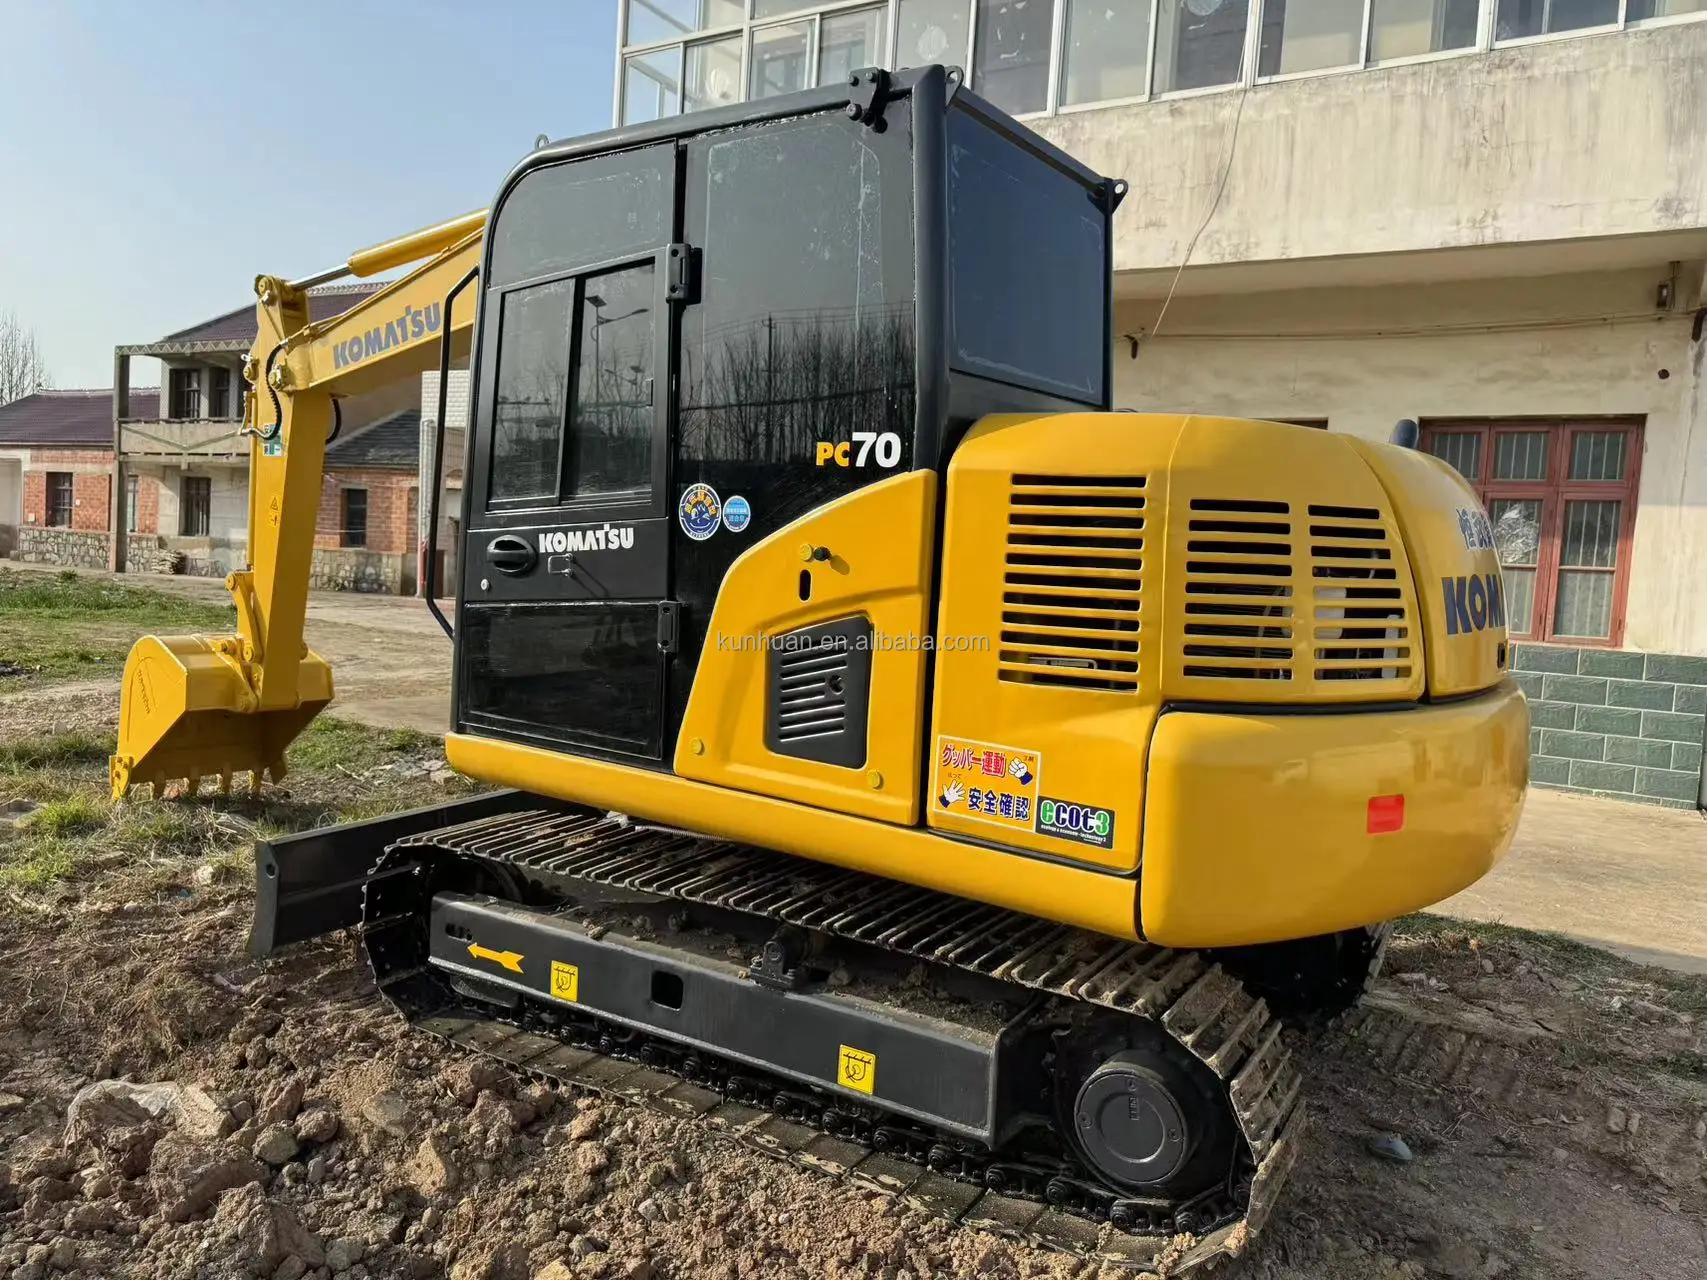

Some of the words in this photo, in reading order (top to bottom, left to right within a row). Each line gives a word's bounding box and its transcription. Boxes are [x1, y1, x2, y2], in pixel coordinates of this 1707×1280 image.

[333, 301, 441, 370] KOMATSU
[816, 431, 901, 468] PC70
[539, 524, 634, 553] KOMATSU
[1441, 573, 1506, 635] KOM
[942, 744, 1006, 778] グッパー運動
[968, 787, 1032, 821] 安全確認
[1040, 799, 1110, 836] ecot3
